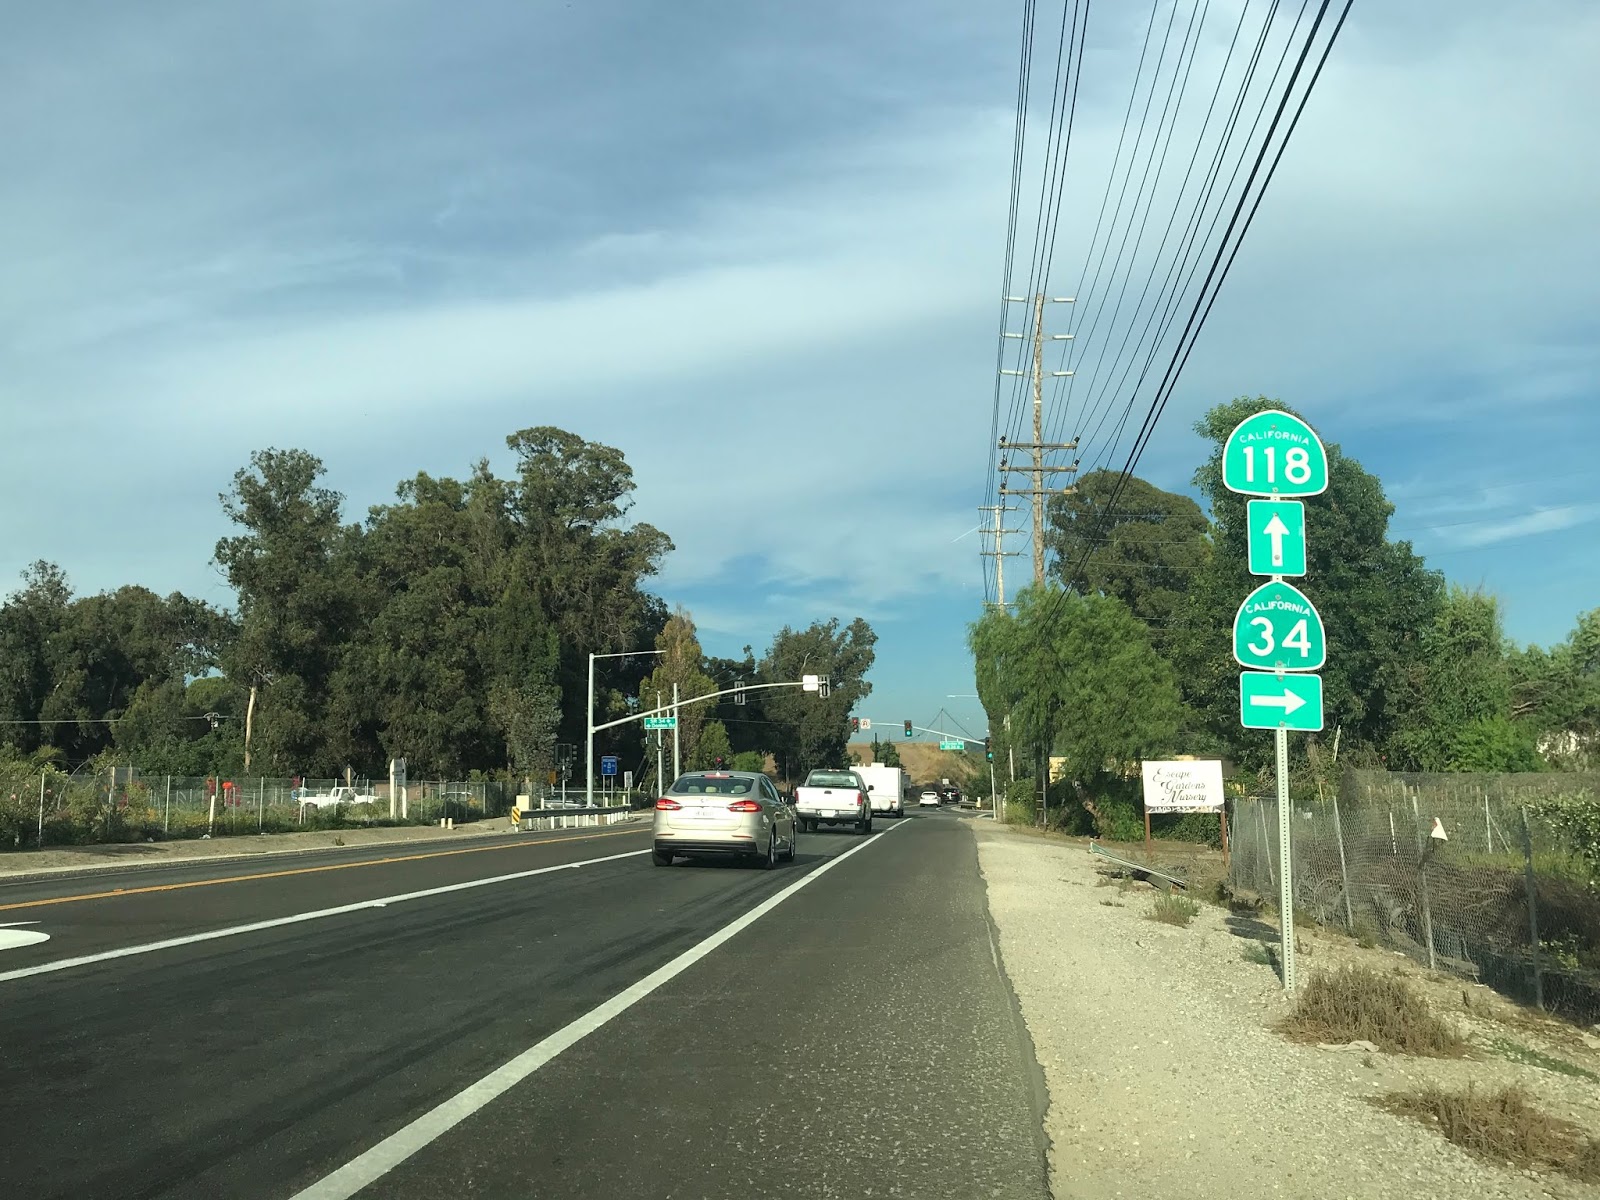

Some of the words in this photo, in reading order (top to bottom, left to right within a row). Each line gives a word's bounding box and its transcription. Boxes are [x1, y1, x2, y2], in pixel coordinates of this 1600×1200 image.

[1239, 430, 1310, 446] CALIFORNIA
[1242, 446, 1312, 485] 118
[1245, 601, 1311, 617] CALIFORNIA
[1247, 616, 1312, 658] 34
[1152, 768, 1192, 782] Escape
[1160, 780, 1206, 795] Gardens
[1161, 789, 1207, 805] Nursery
